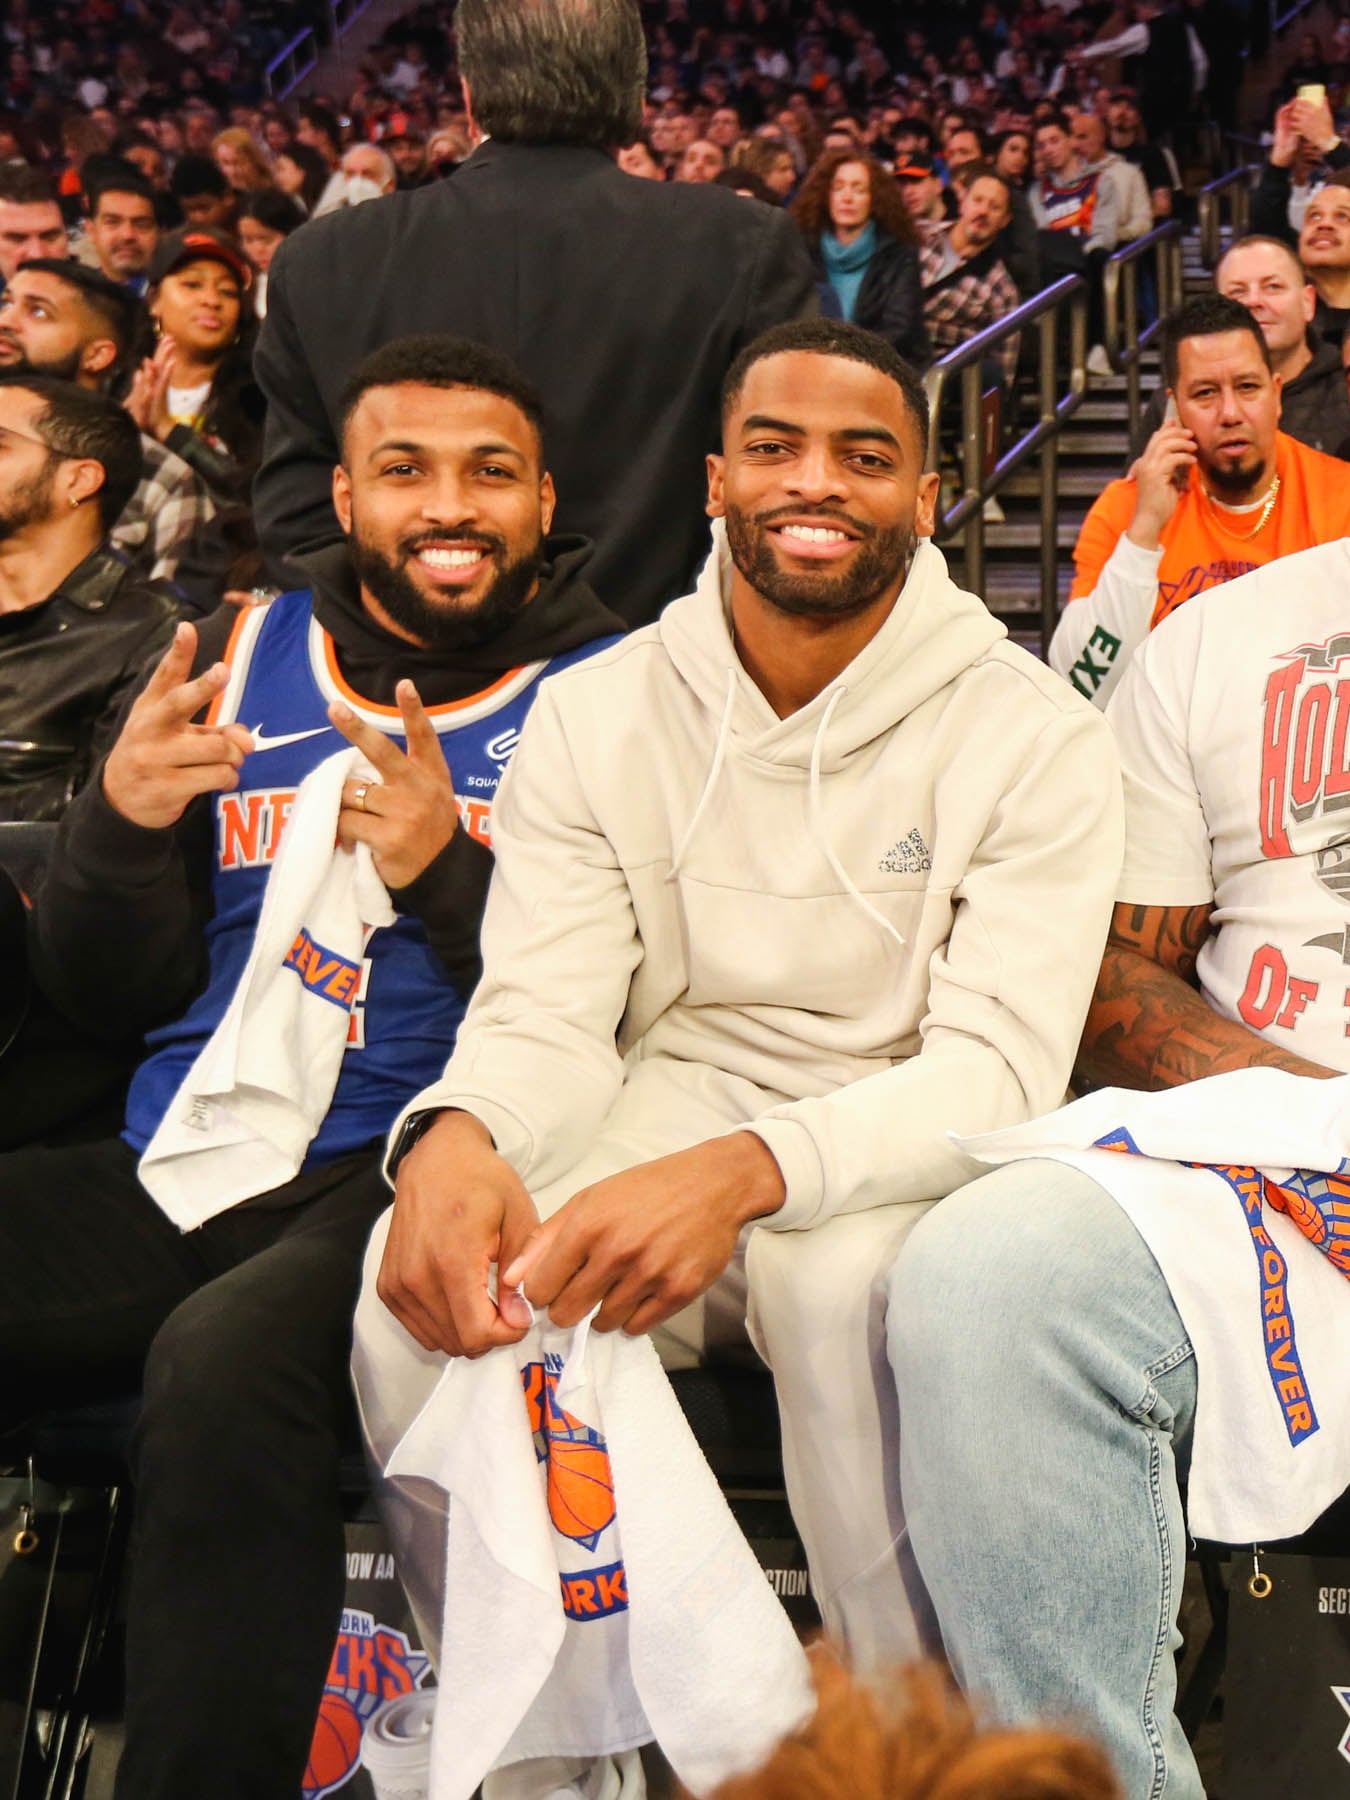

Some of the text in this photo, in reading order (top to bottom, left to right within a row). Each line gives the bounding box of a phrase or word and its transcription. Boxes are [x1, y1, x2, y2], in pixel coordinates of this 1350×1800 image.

[218, 787, 298, 870] NE
[1237, 943, 1318, 1031] OF
[1250, 1225, 1313, 1436] FOREVER
